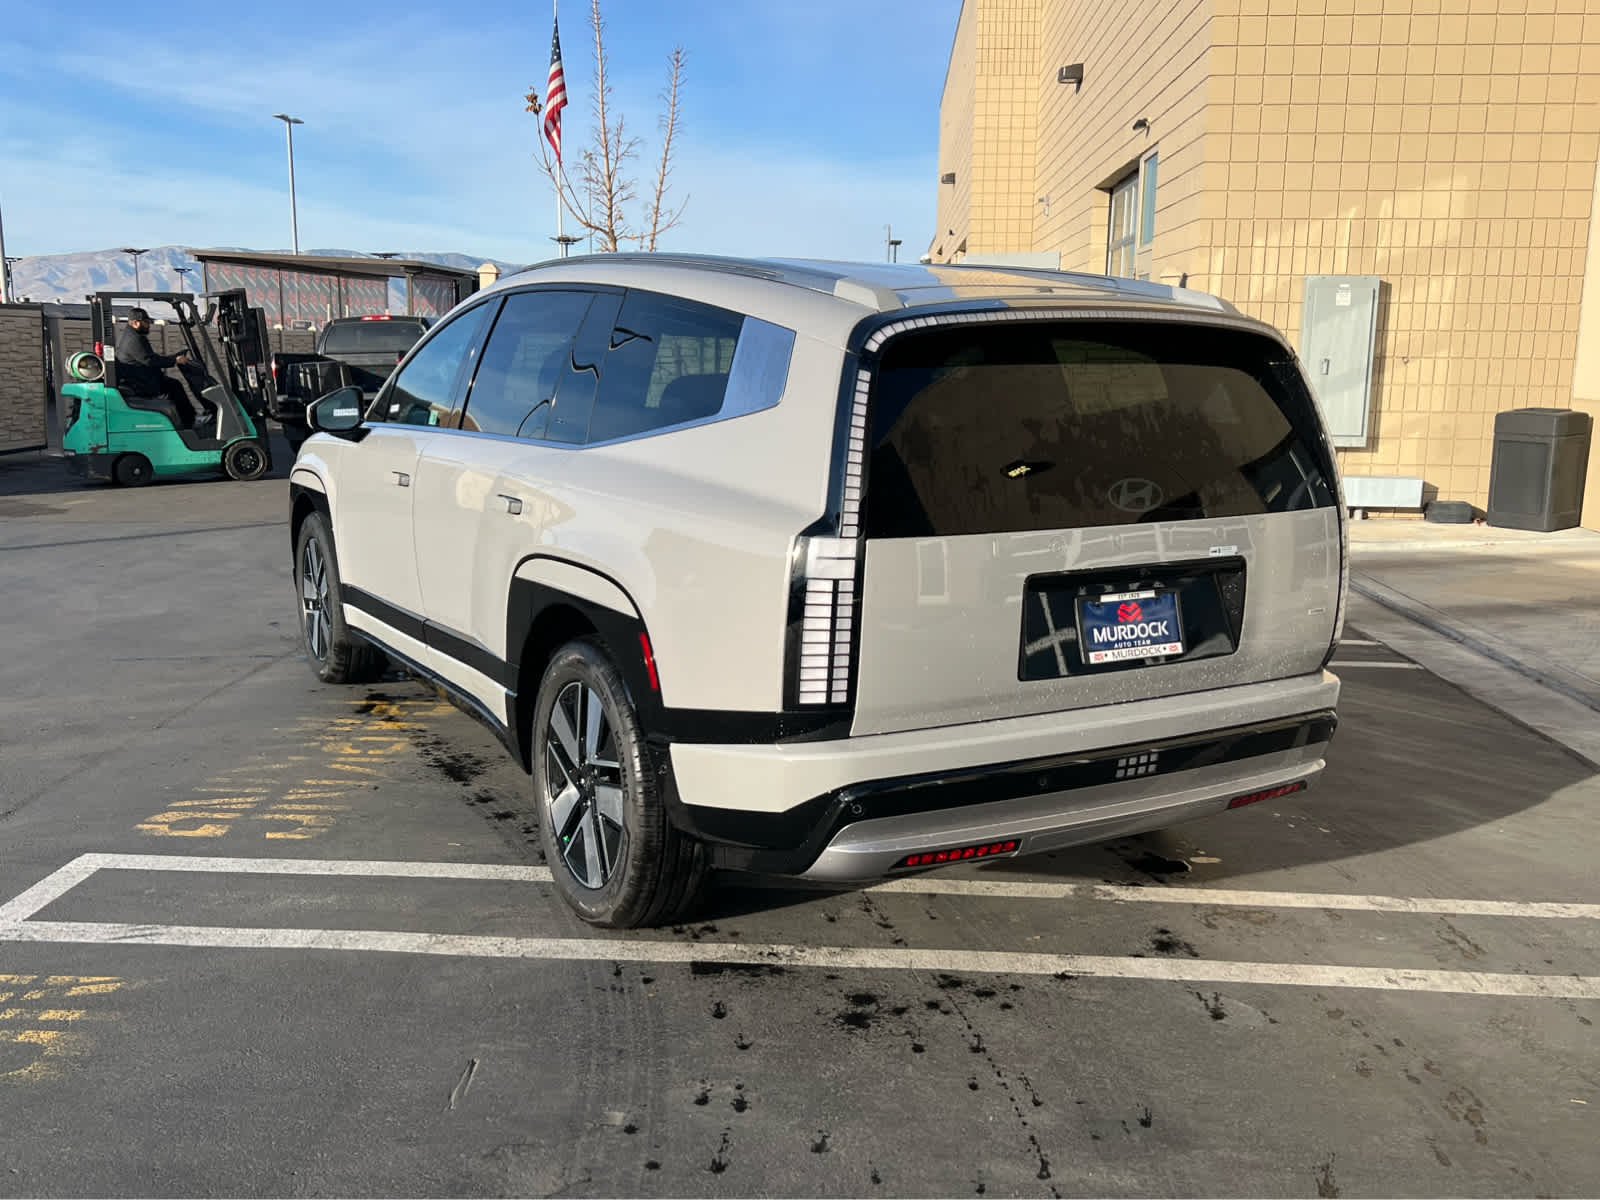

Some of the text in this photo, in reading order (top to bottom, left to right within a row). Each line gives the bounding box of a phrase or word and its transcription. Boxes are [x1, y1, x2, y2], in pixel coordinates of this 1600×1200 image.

[1093, 620, 1168, 643] MURDOCK
[1114, 641, 1132, 649] AUTO
[1111, 646, 1161, 659] MURDOCK
